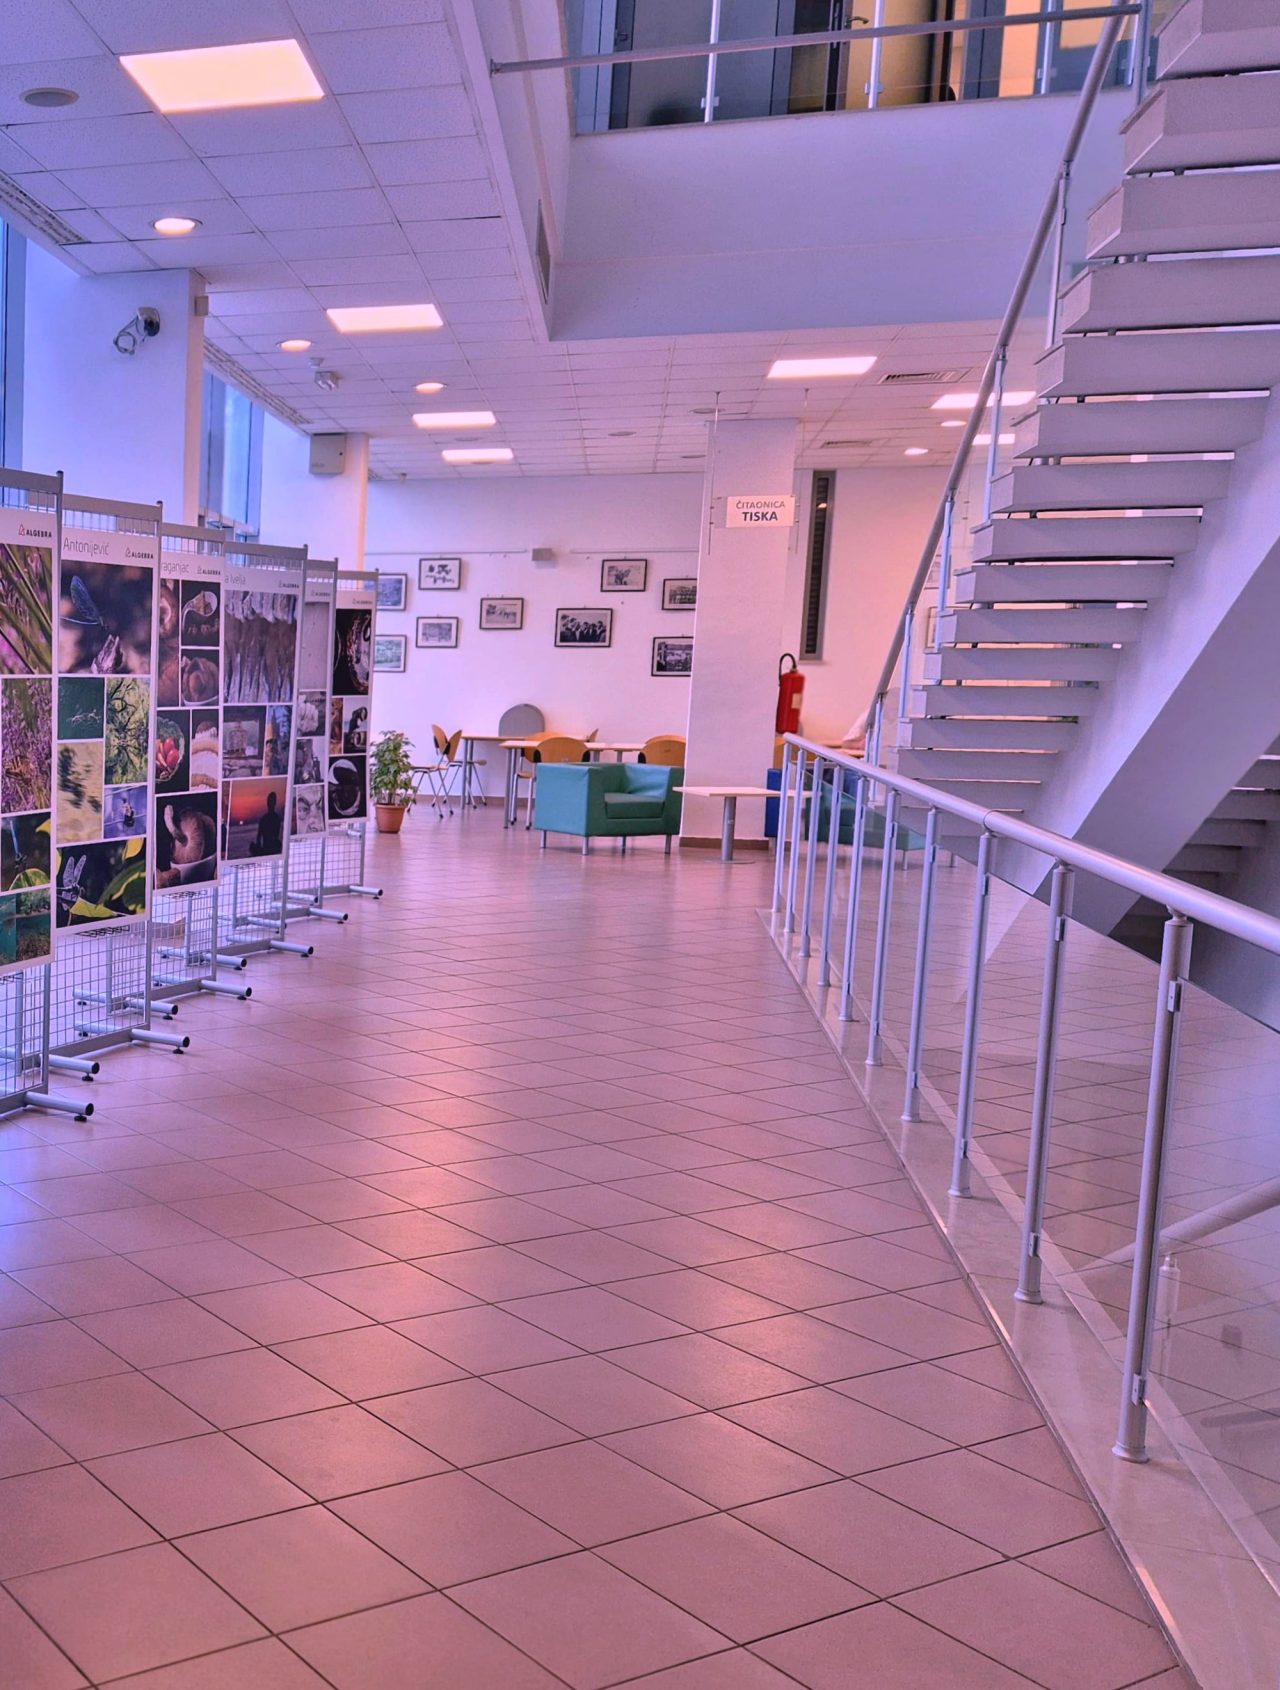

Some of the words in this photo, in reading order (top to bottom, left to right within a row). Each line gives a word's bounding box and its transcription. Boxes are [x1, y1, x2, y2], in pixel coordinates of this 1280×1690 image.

[736, 500, 786, 510] ČITAONICA
[742, 511, 778, 522] TISKA
[26, 528, 53, 538] ALGEBRA
